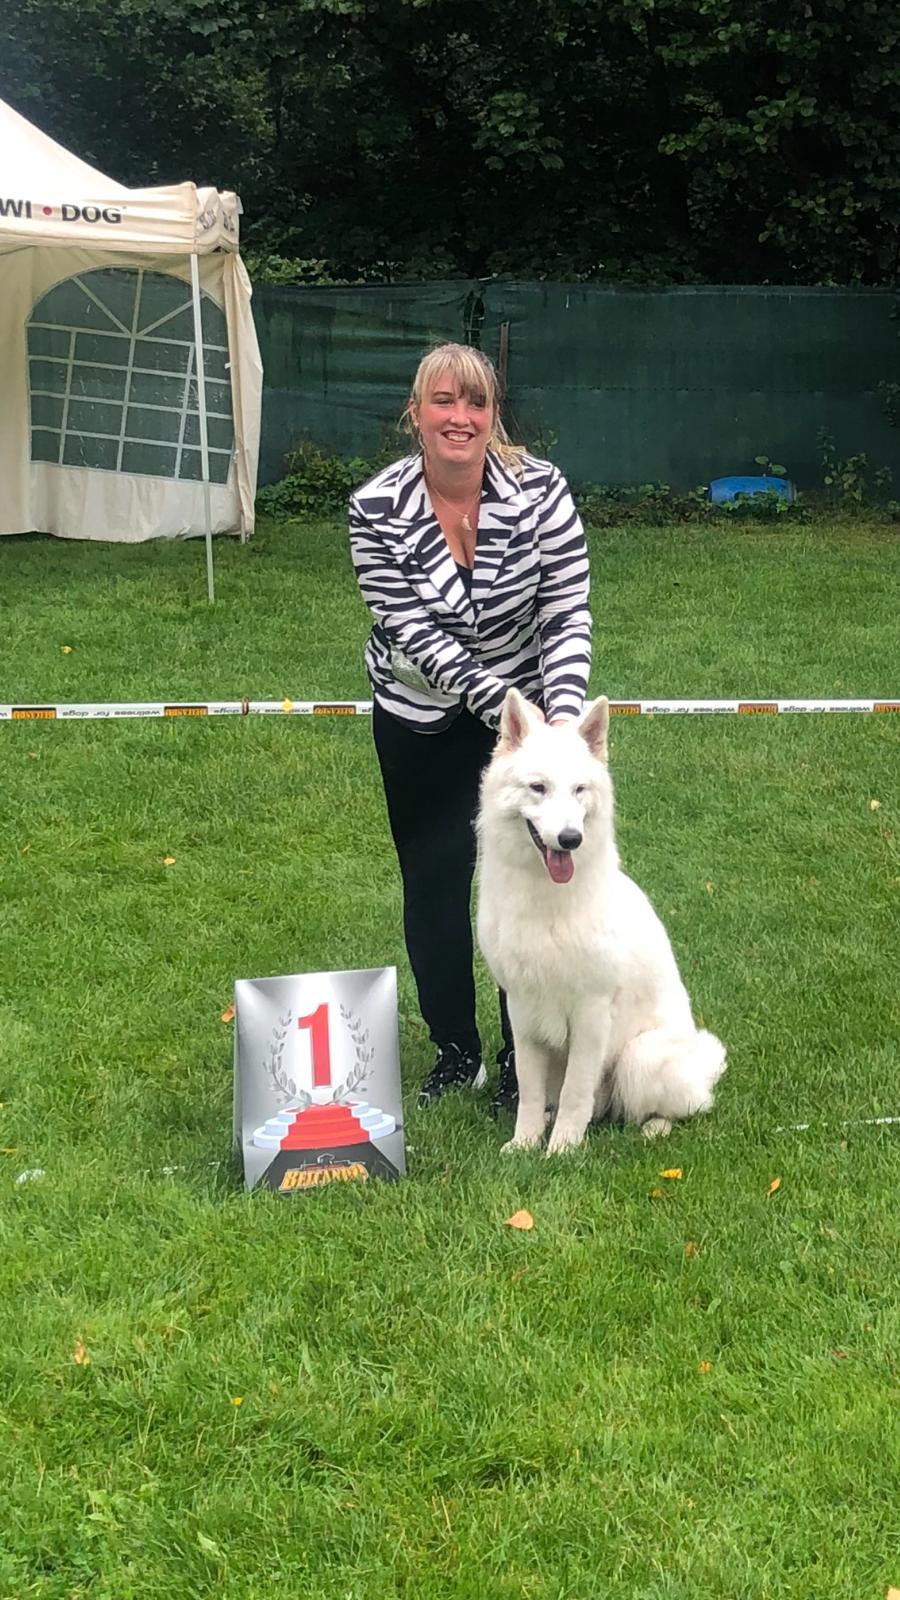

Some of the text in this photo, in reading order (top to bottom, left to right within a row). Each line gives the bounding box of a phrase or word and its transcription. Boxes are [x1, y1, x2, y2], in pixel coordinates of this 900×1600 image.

[62, 204, 122, 224] DOG
[62, 709, 89, 717] dogs
[645, 705, 671, 713] dogs
[783, 705, 807, 713] dogs
[829, 705, 870, 713] wellness
[297, 1002, 333, 1090] 1
